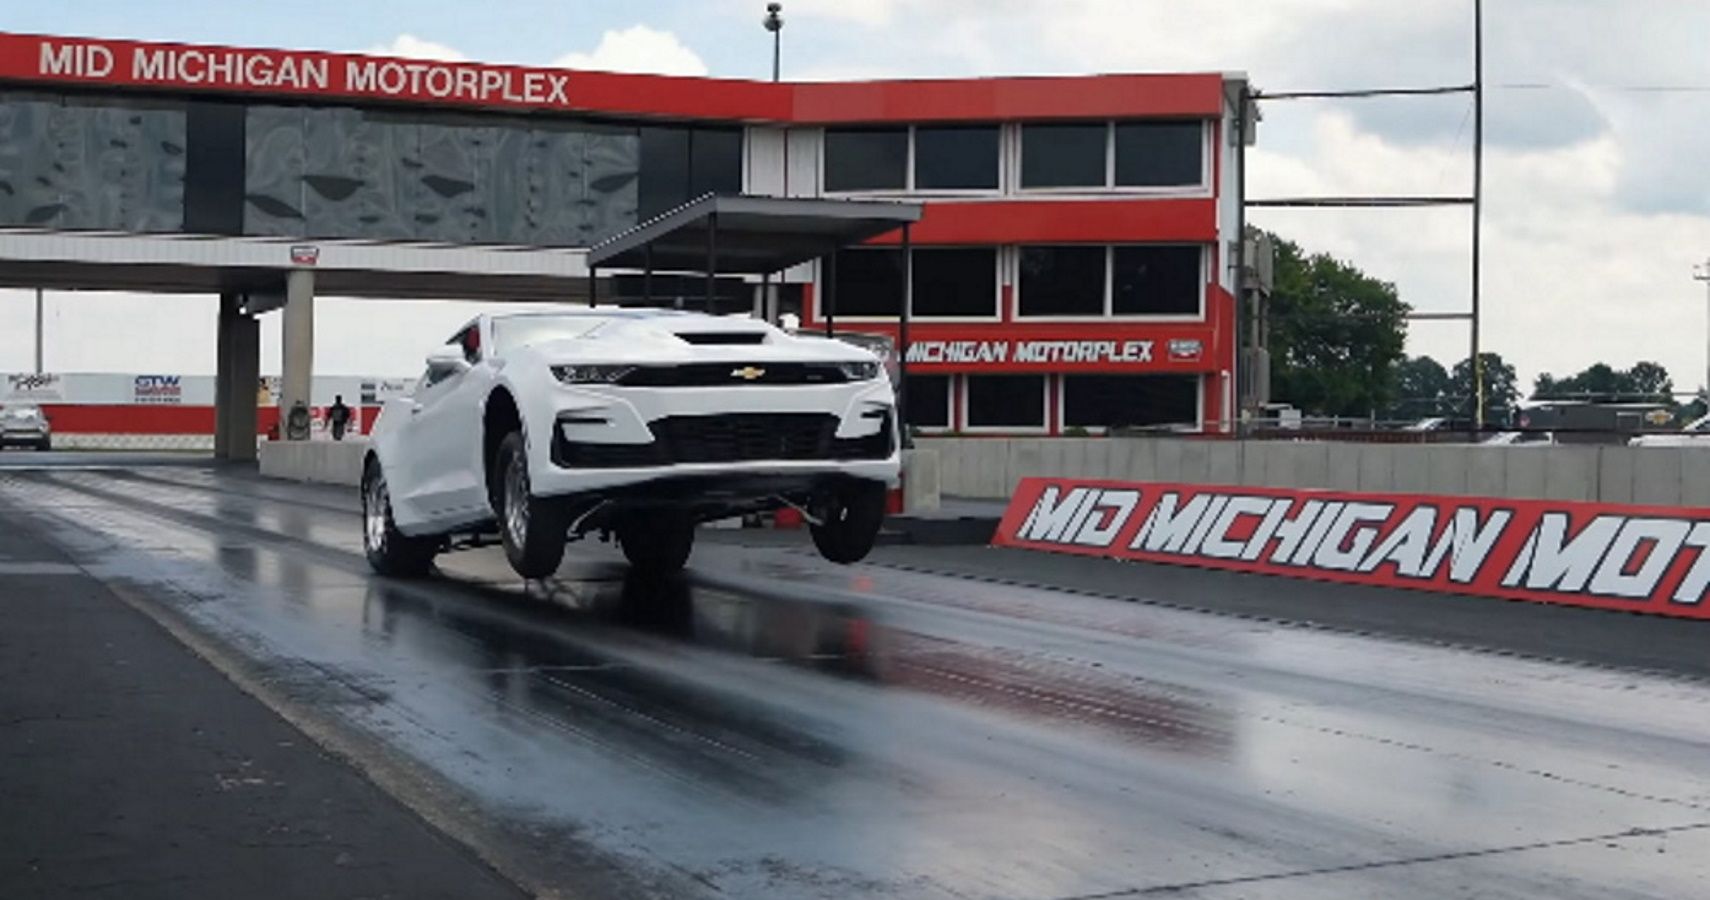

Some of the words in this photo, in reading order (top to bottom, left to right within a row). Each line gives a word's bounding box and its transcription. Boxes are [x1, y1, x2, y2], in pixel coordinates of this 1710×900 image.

[38, 42, 115, 79] MID
[131, 48, 329, 90] MICHIGAN
[345, 61, 572, 105] MOTORPLEX
[1013, 341, 1154, 362] MOTORPLEX
[1015, 486, 1141, 546] MID
[1131, 491, 1511, 582] MICHIGAN
